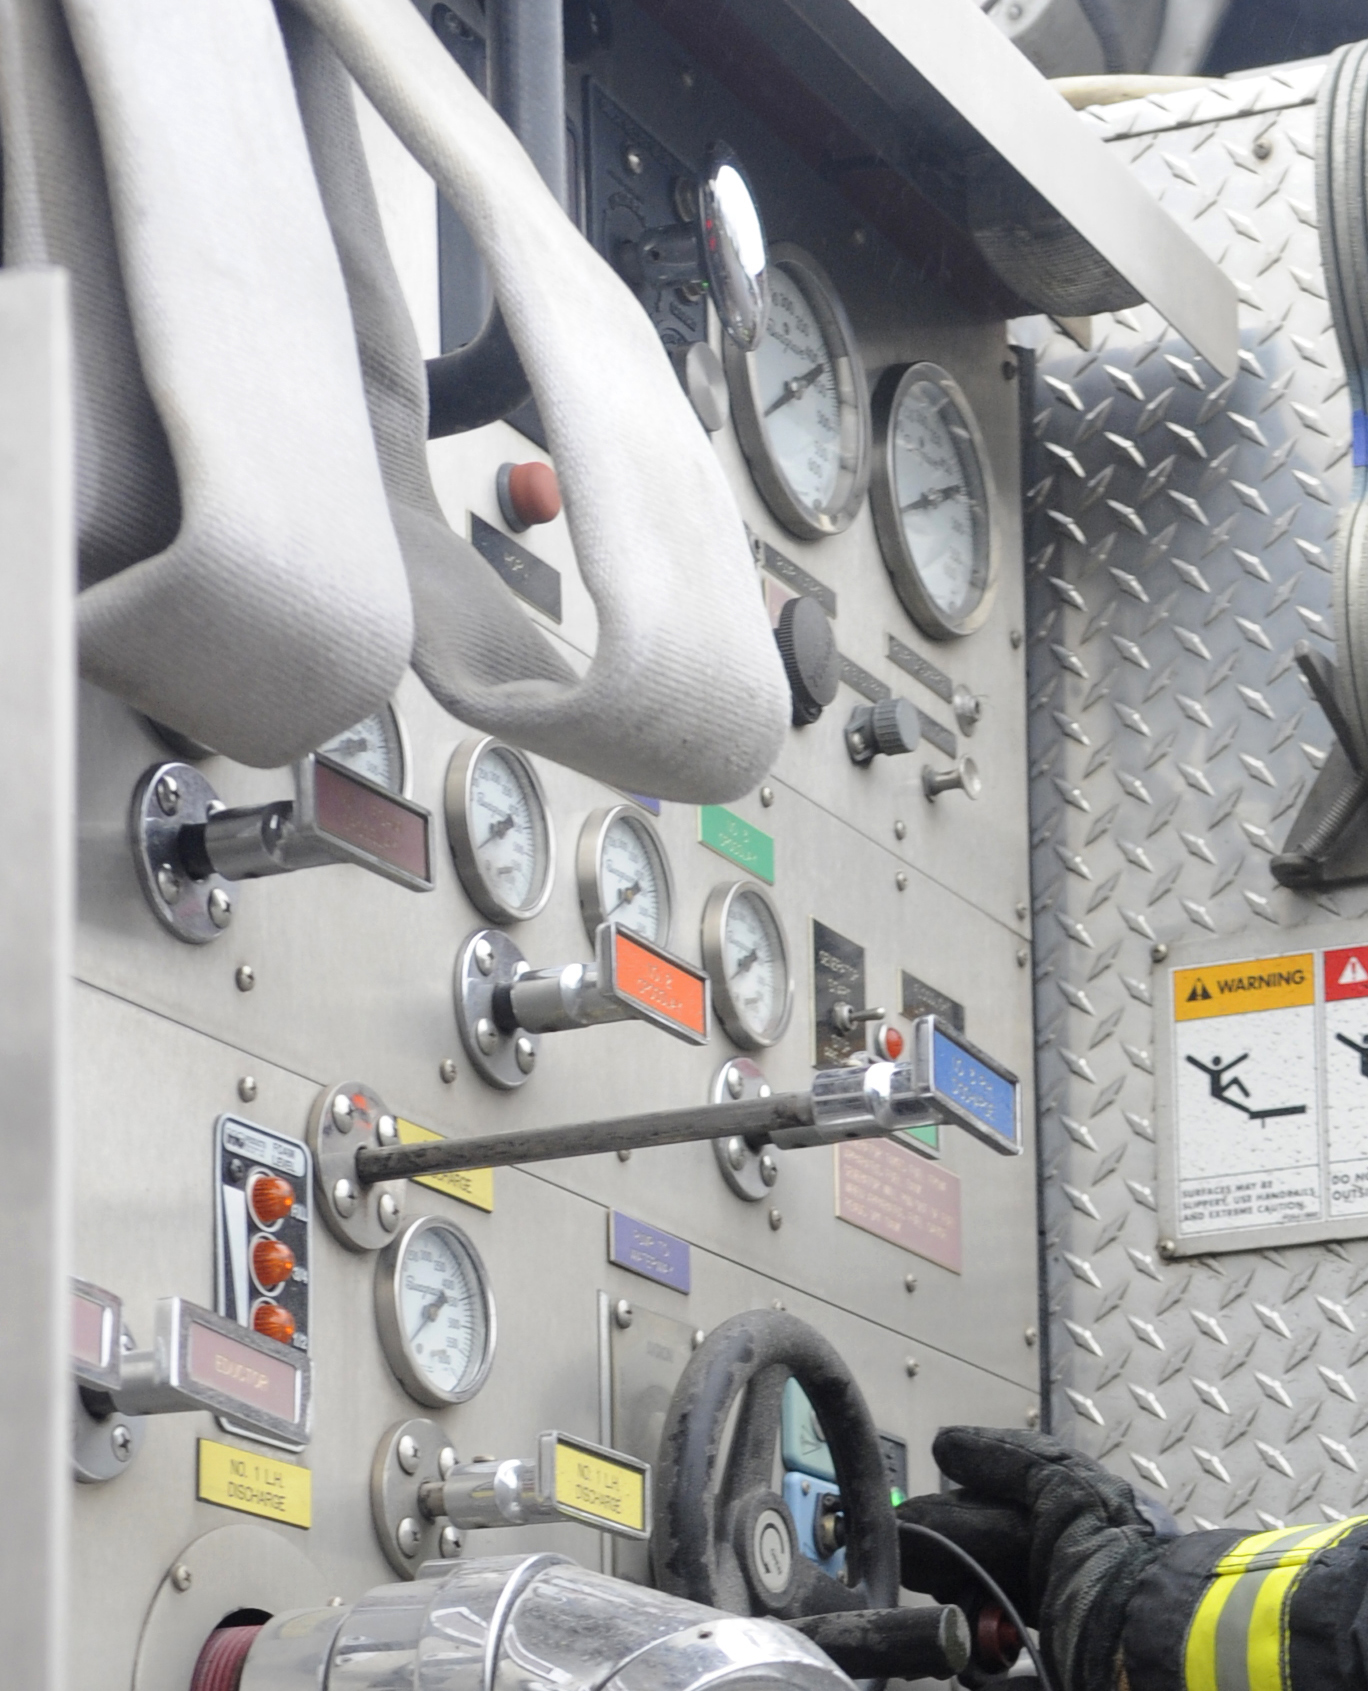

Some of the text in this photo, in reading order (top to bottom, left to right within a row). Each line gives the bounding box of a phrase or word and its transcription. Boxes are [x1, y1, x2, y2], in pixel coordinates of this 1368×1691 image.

[1217, 969, 1306, 995] WARNING
[1235, 1182, 1258, 1192] MAY
[1331, 1174, 1351, 1186] DO
[1233, 1194, 1253, 1205] USE
[1183, 1211, 1205, 1221] AND
[1208, 1206, 1254, 1219] EXTREME
[226, 1480, 287, 1513] DISCHARGE
[574, 1483, 622, 1515] DISCHARGE
